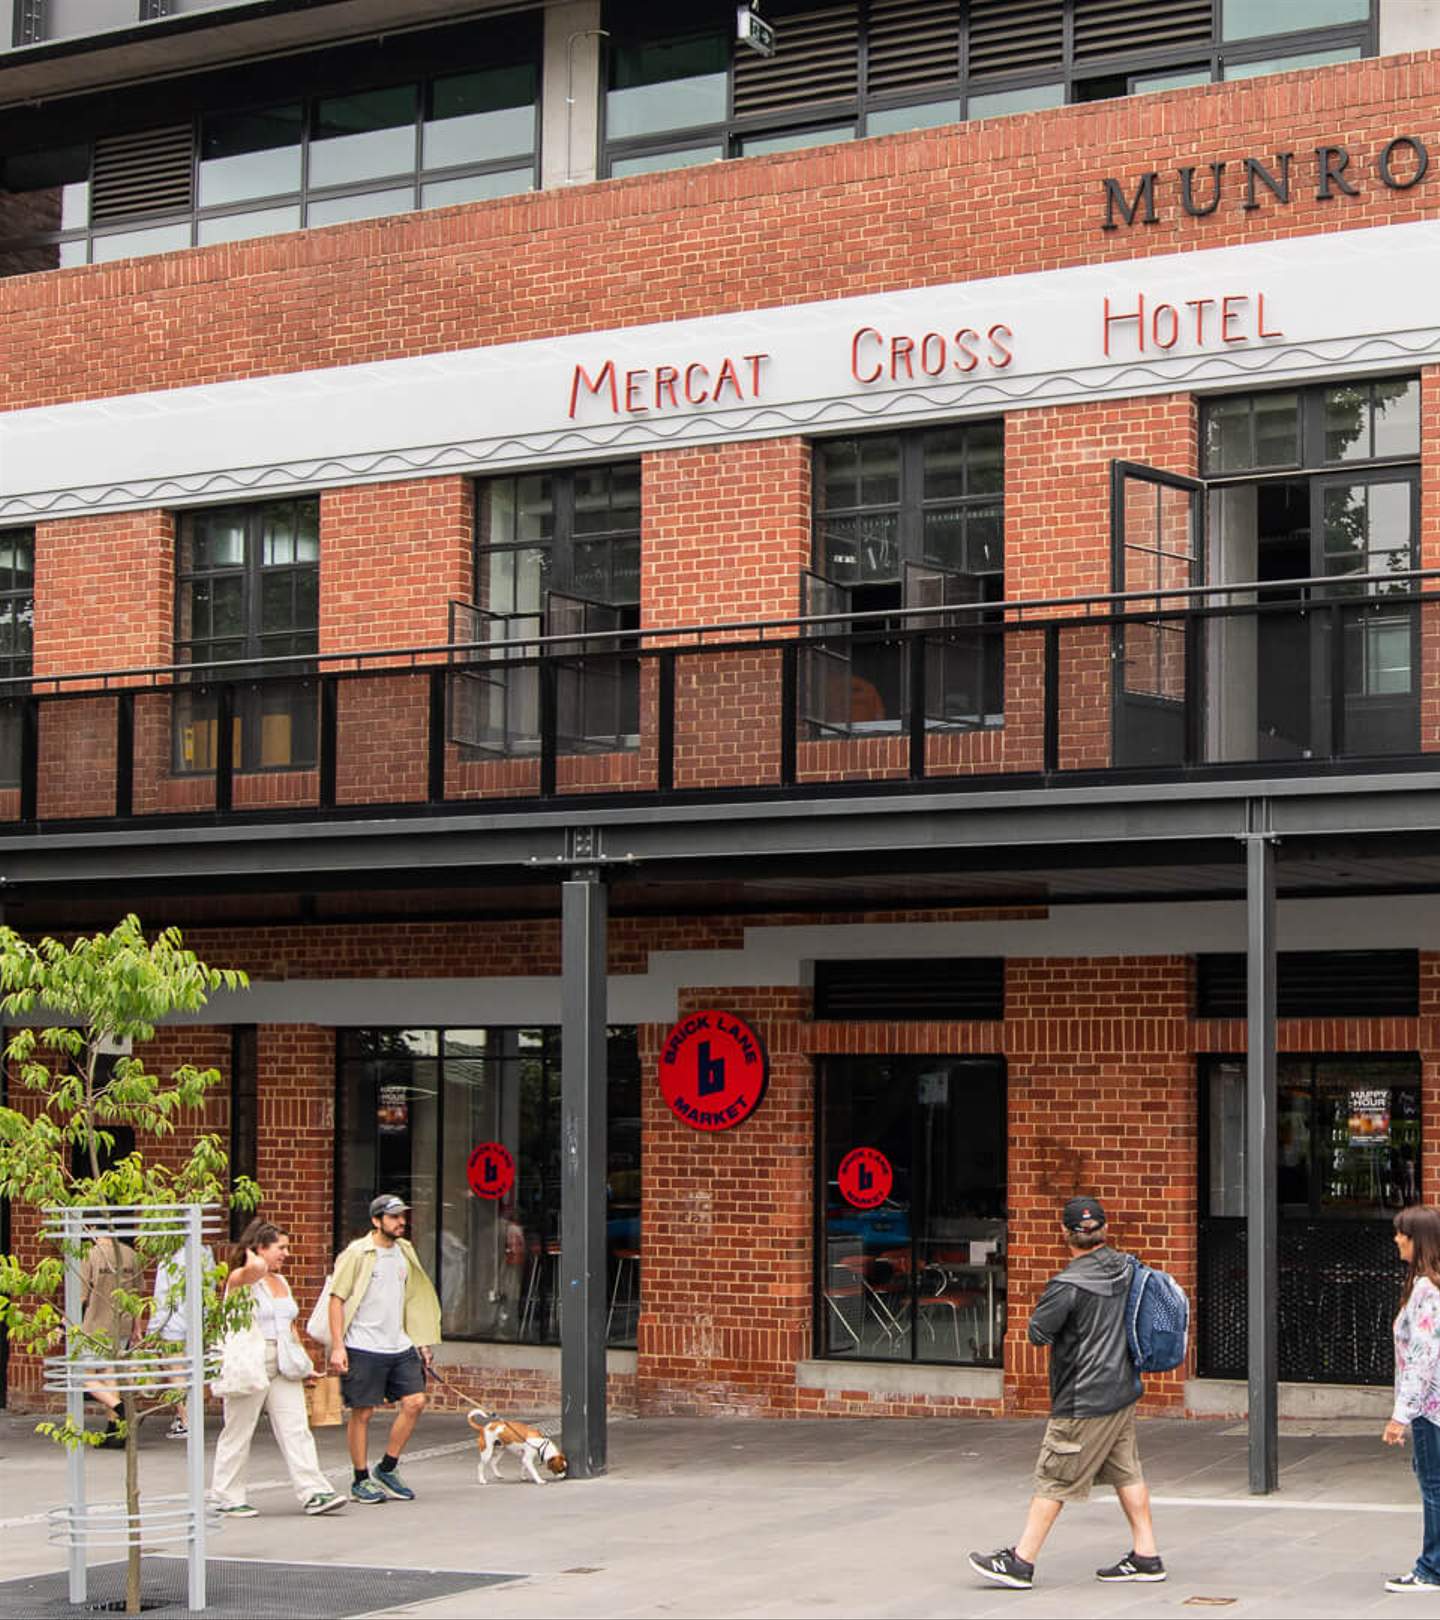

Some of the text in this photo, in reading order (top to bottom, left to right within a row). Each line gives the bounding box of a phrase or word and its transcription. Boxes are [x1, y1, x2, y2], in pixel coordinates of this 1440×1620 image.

[568, 292, 1284, 420] MERCAT CROSS HOTEL
[663, 1015, 758, 1066] BRICK LANE
[697, 1040, 725, 1098] b
[673, 1094, 748, 1126] MARKET
[1350, 1091, 1388, 1099] HAPPY
[1352, 1098, 1386, 1107] HOUR
